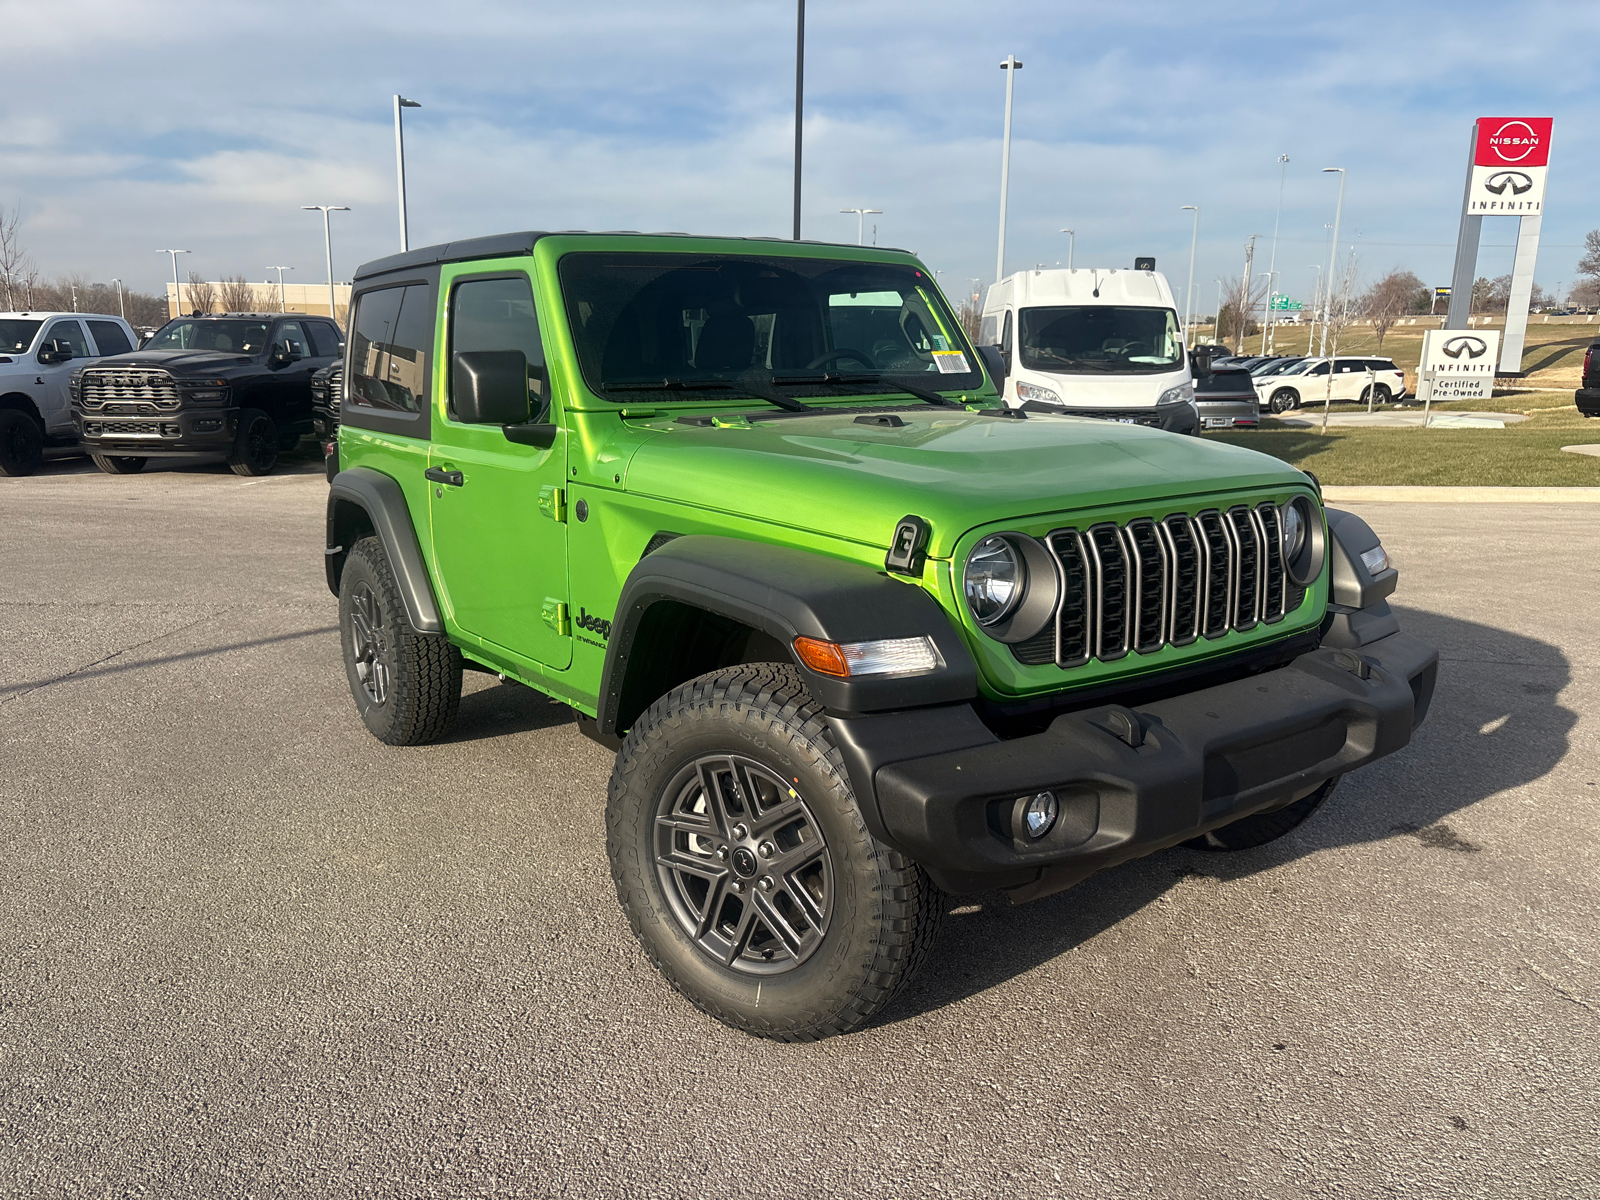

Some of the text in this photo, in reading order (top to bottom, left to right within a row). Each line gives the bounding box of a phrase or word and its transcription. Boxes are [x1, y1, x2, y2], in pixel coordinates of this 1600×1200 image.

[1489, 137, 1539, 145] NISSAN
[1471, 201, 1540, 210] INFINITI
[1432, 364, 1491, 372] INFINITI
[101, 377, 149, 386] RAM
[1438, 380, 1480, 388] Certified
[1432, 389, 1484, 397] Pre-Owned
[575, 606, 613, 641] Jeep
